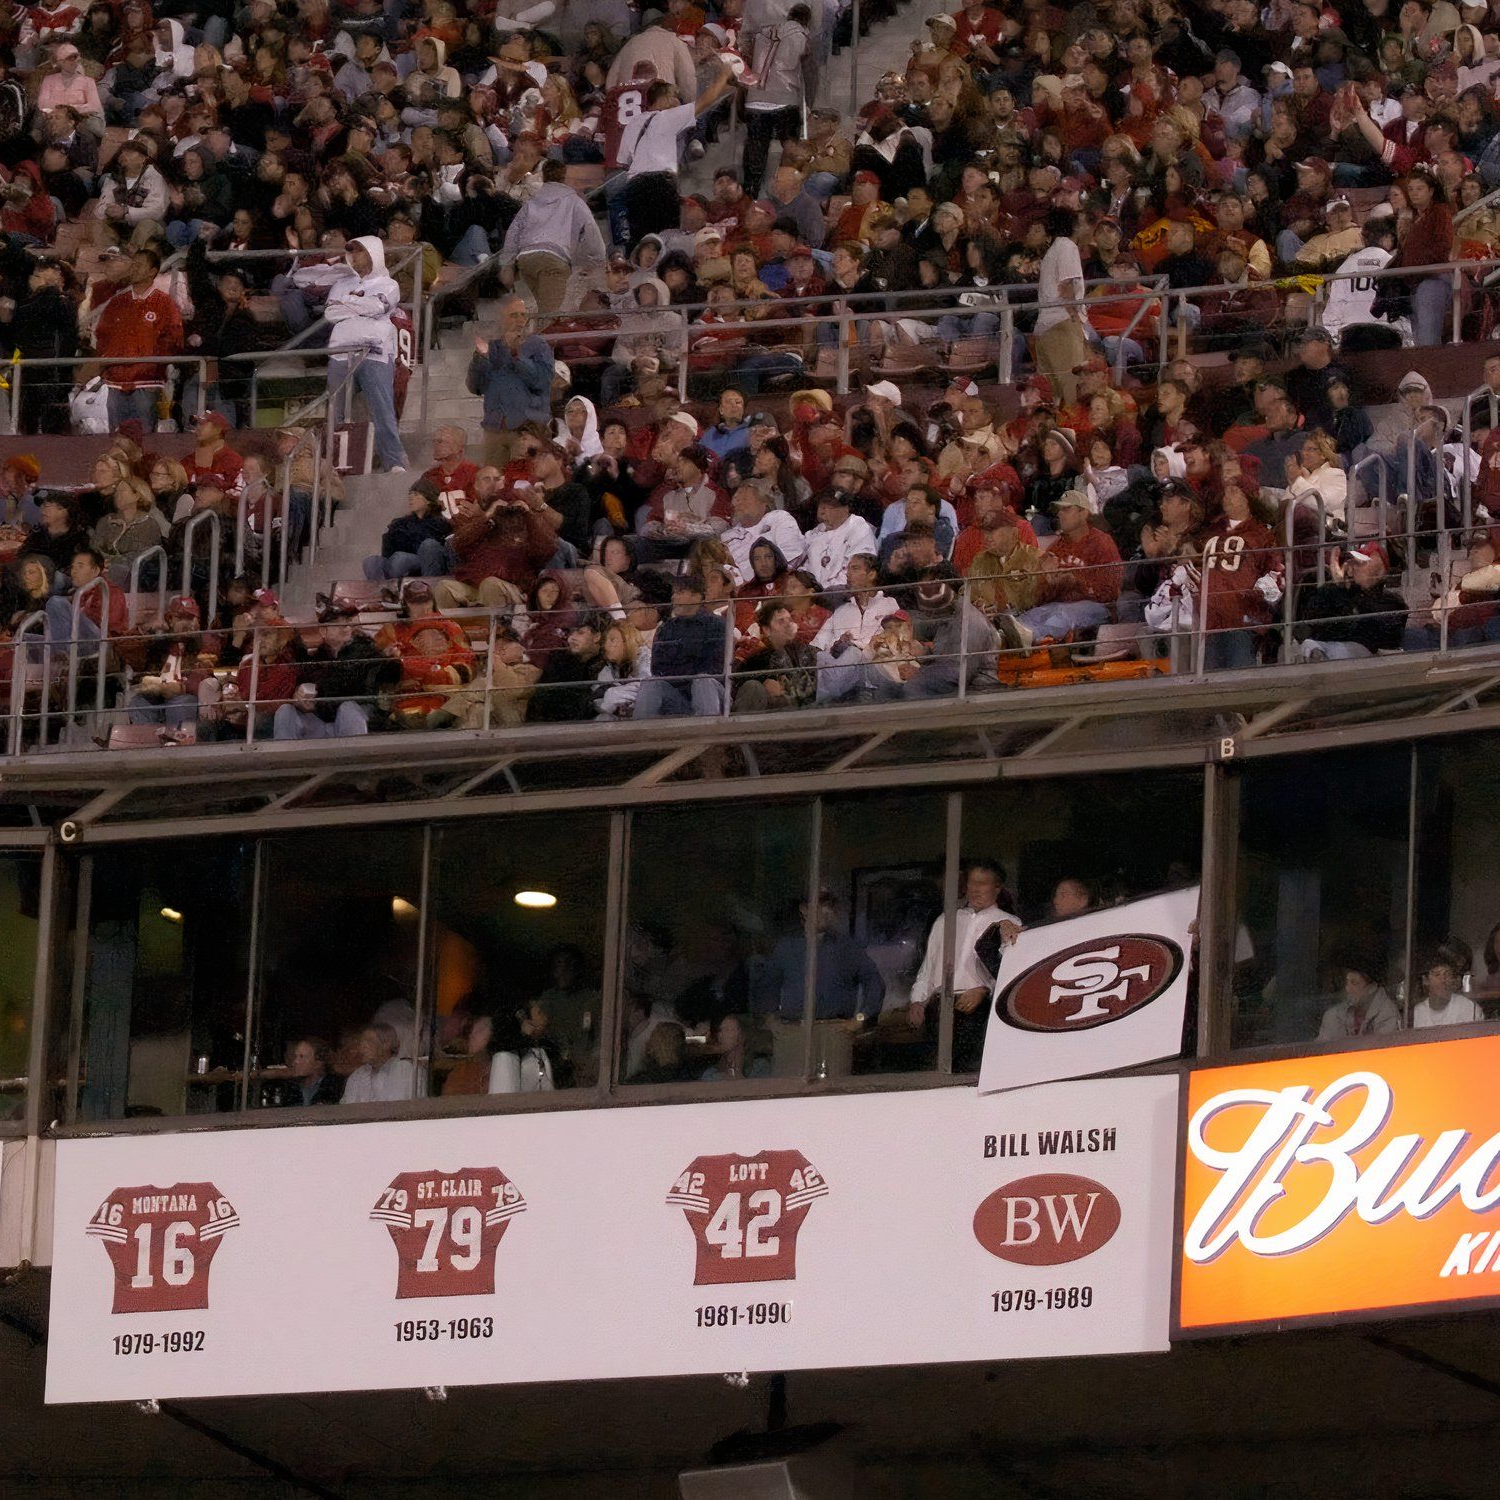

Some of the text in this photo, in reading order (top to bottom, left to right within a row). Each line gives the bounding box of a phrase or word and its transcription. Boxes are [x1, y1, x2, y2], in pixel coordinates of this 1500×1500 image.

[1221, 738, 1234, 758] B
[60, 821, 76, 841] C
[984, 1127, 1117, 1158] BILL WALSH
[673, 1171, 706, 1195] 42
[729, 1163, 769, 1182] LOTT
[789, 1165, 820, 1190] 42
[132, 1194, 197, 1214] MONTANA
[380, 1188, 408, 1211] 79
[492, 1182, 520, 1207] 79
[97, 1202, 124, 1225] 16
[207, 1197, 233, 1222] 16
[999, 1192, 1101, 1247] BW
[704, 1189, 782, 1259] 42
[414, 1206, 482, 1272] 79
[131, 1221, 196, 1288] 16
[991, 1286, 1093, 1312] 1979-1989
[695, 1302, 792, 1328] 1981-1990
[394, 1317, 494, 1342] 1953-1963
[113, 1330, 205, 1356] 1979-1992
